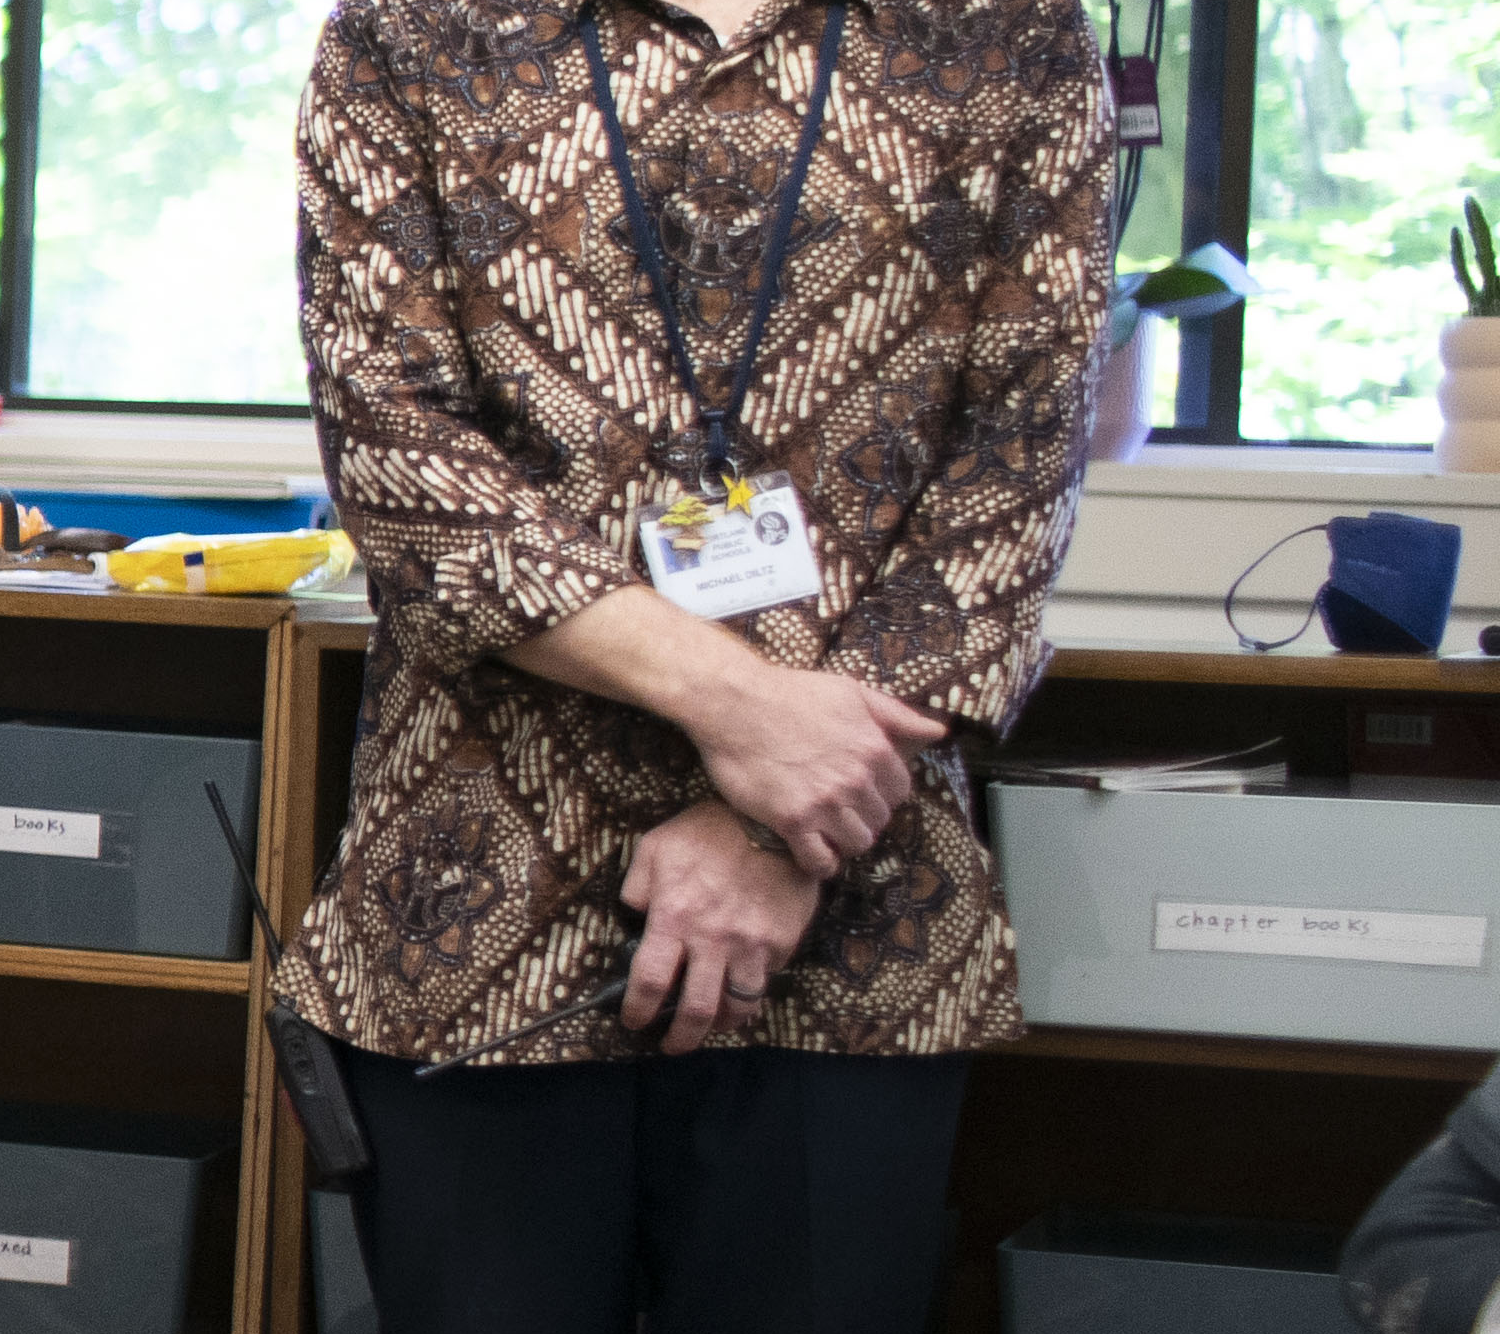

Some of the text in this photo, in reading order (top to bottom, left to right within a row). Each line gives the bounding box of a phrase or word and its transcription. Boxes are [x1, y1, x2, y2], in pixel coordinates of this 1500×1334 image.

[13, 814, 66, 835] books
[1176, 910, 1371, 935] chapter books
